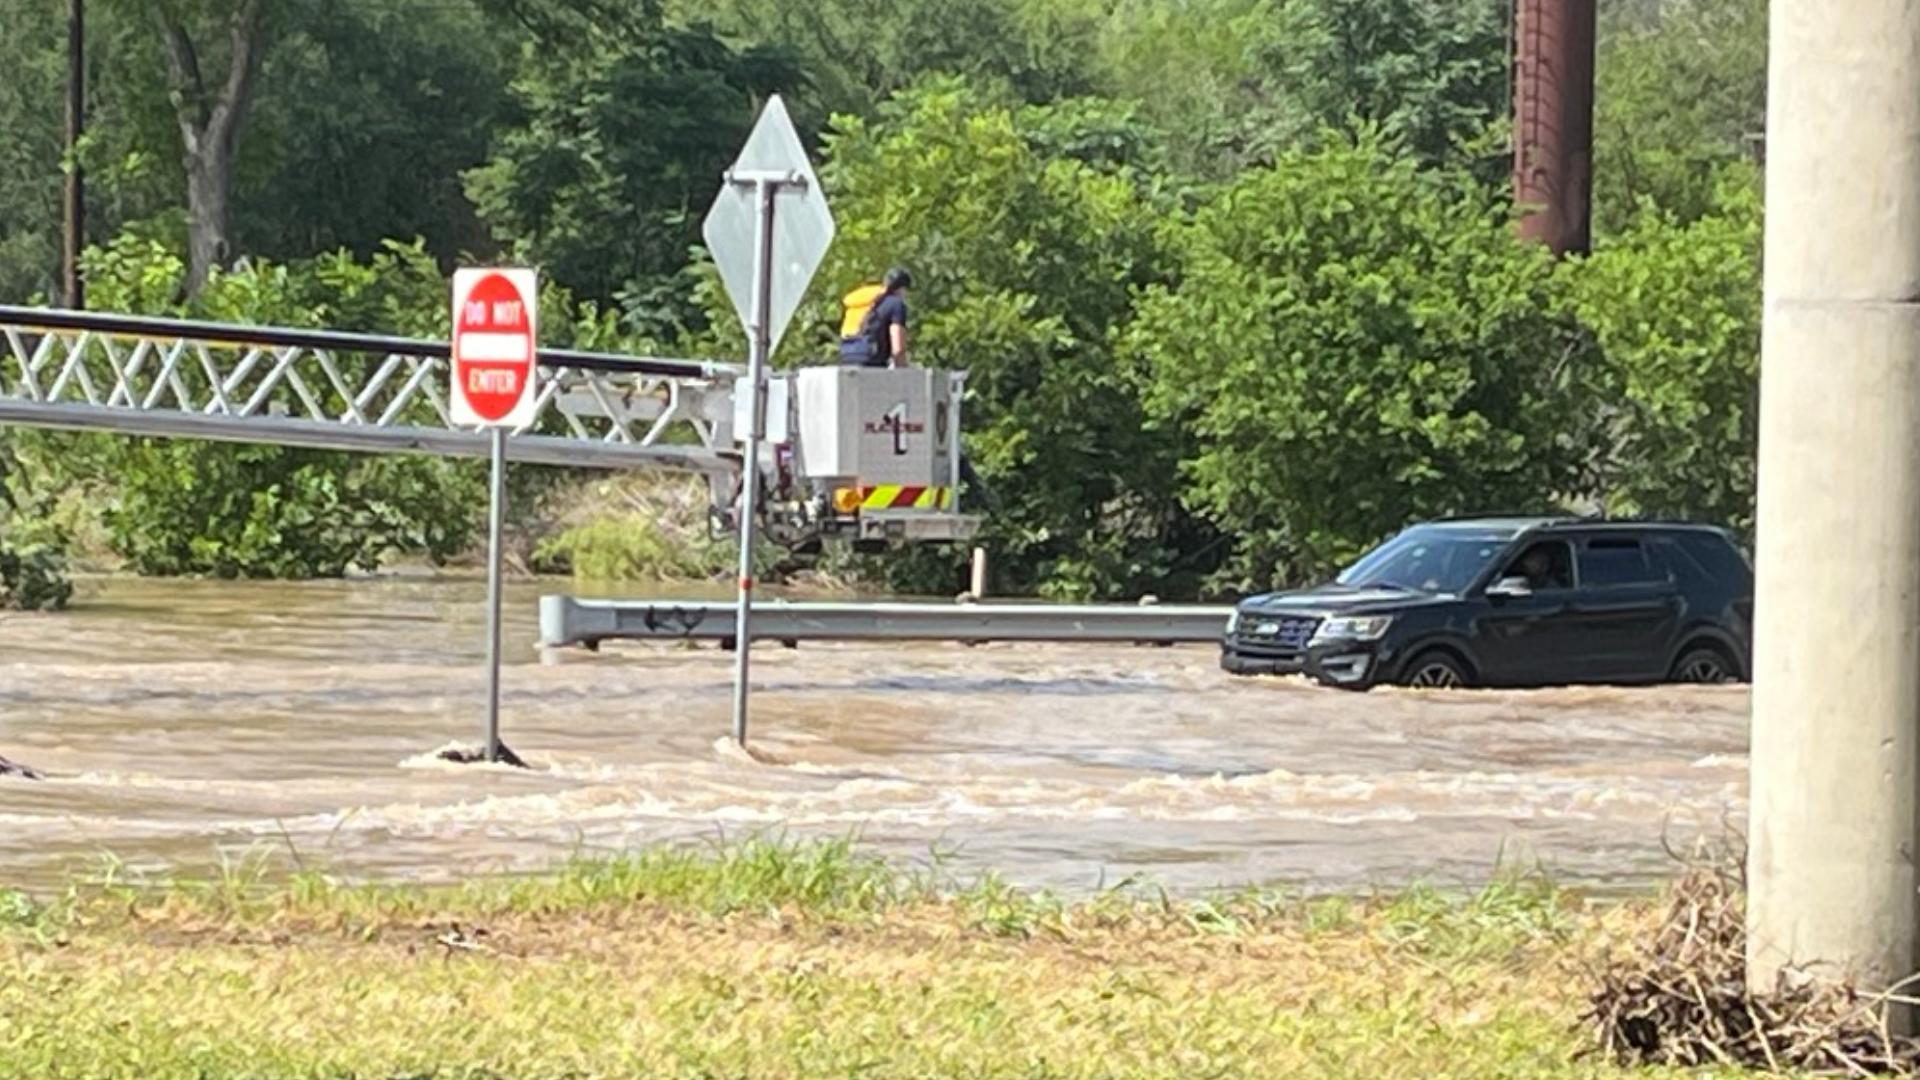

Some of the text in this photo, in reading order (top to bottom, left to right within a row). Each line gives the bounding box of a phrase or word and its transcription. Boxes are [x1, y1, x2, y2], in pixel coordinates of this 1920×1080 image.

[465, 302, 521, 325] DO NOT
[469, 368, 516, 393] ENTER
[883, 402, 907, 455] 1
